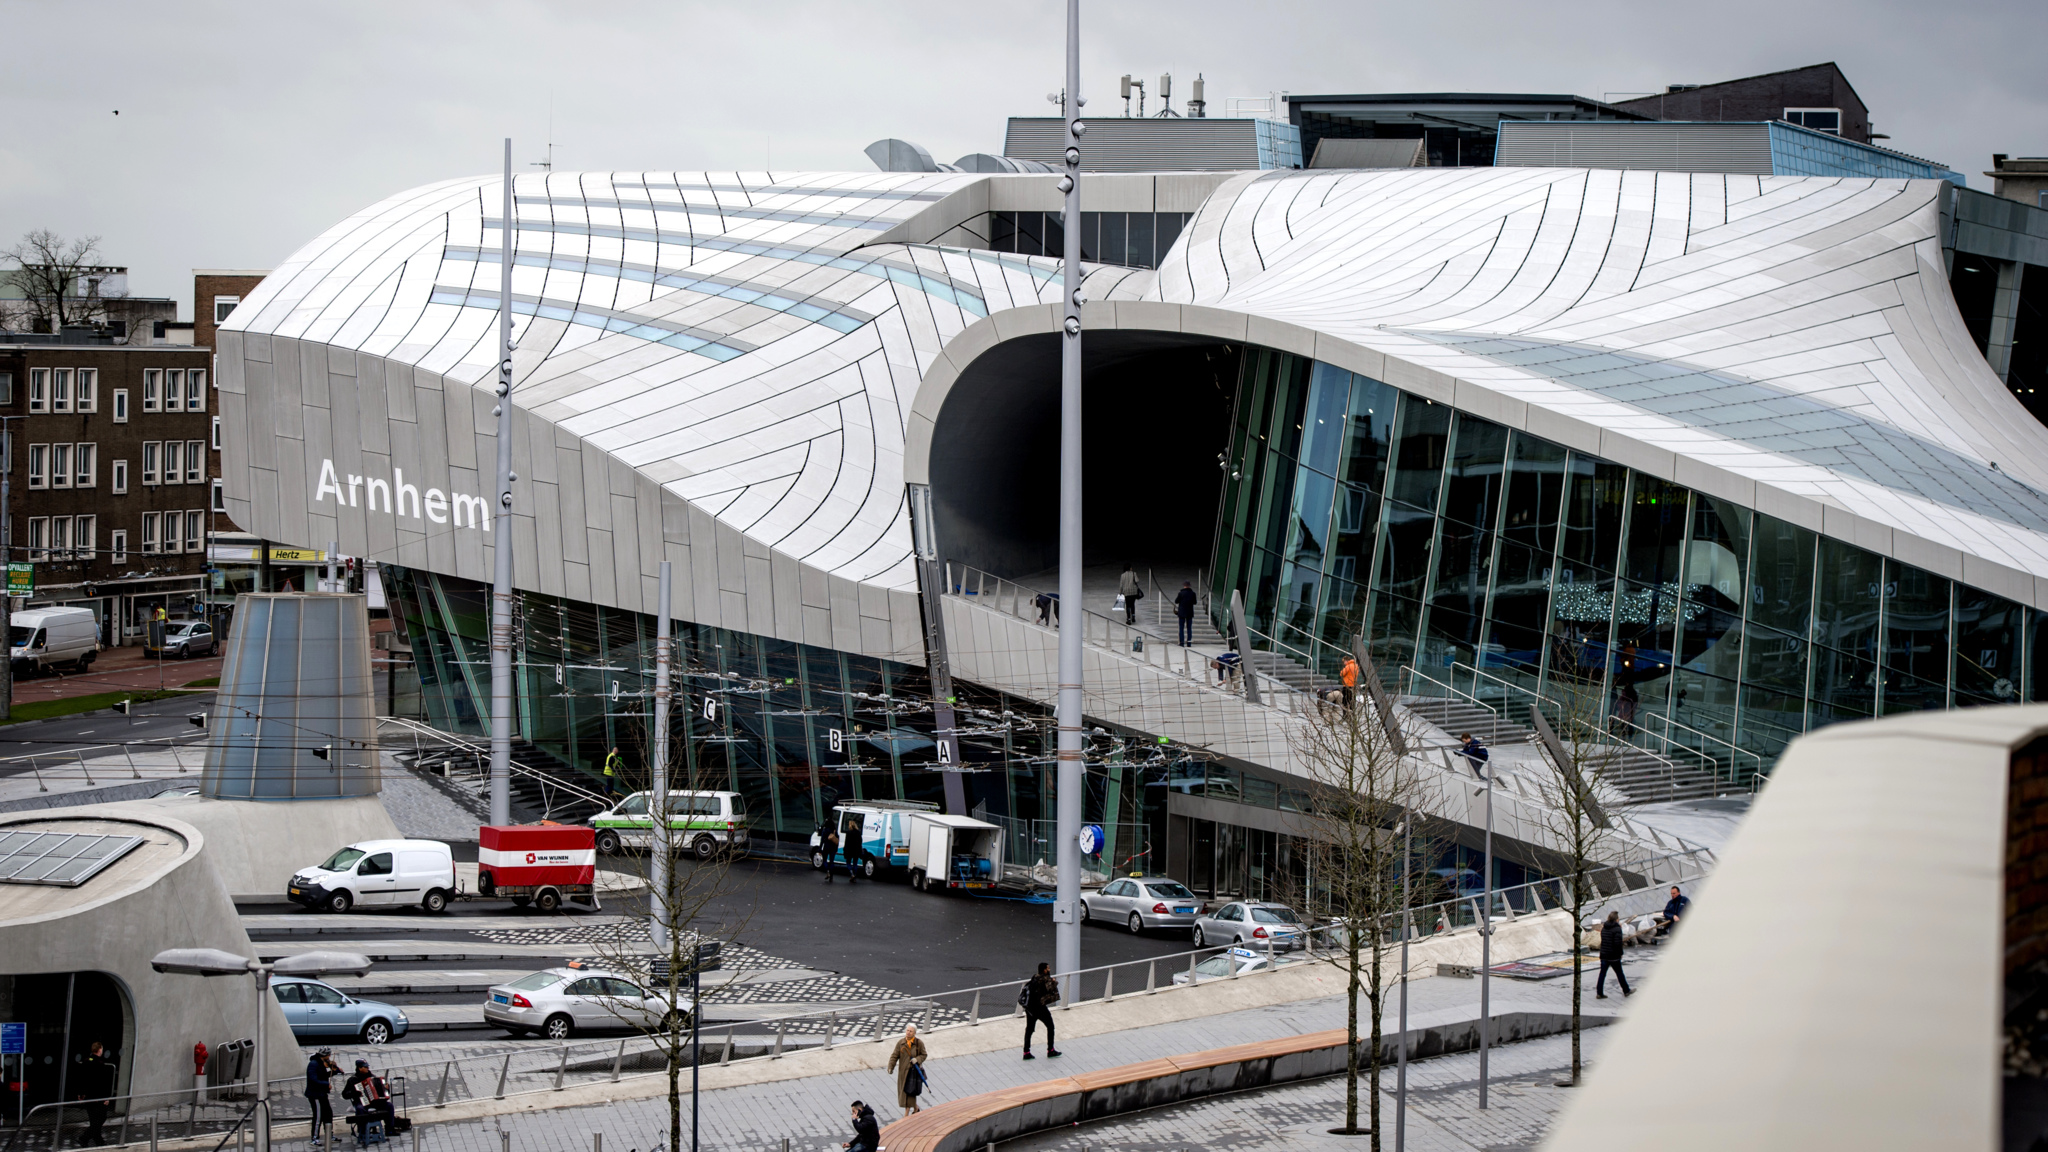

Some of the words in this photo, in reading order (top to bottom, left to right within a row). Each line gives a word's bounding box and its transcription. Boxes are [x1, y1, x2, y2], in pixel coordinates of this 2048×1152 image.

[315, 458, 490, 531] Arnhem
[275, 550, 300, 559] Hertz
[8, 563, 33, 571] OPVALLEN?
[705, 700, 714, 719] C
[832, 730, 840, 750] B
[939, 741, 950, 762] A
